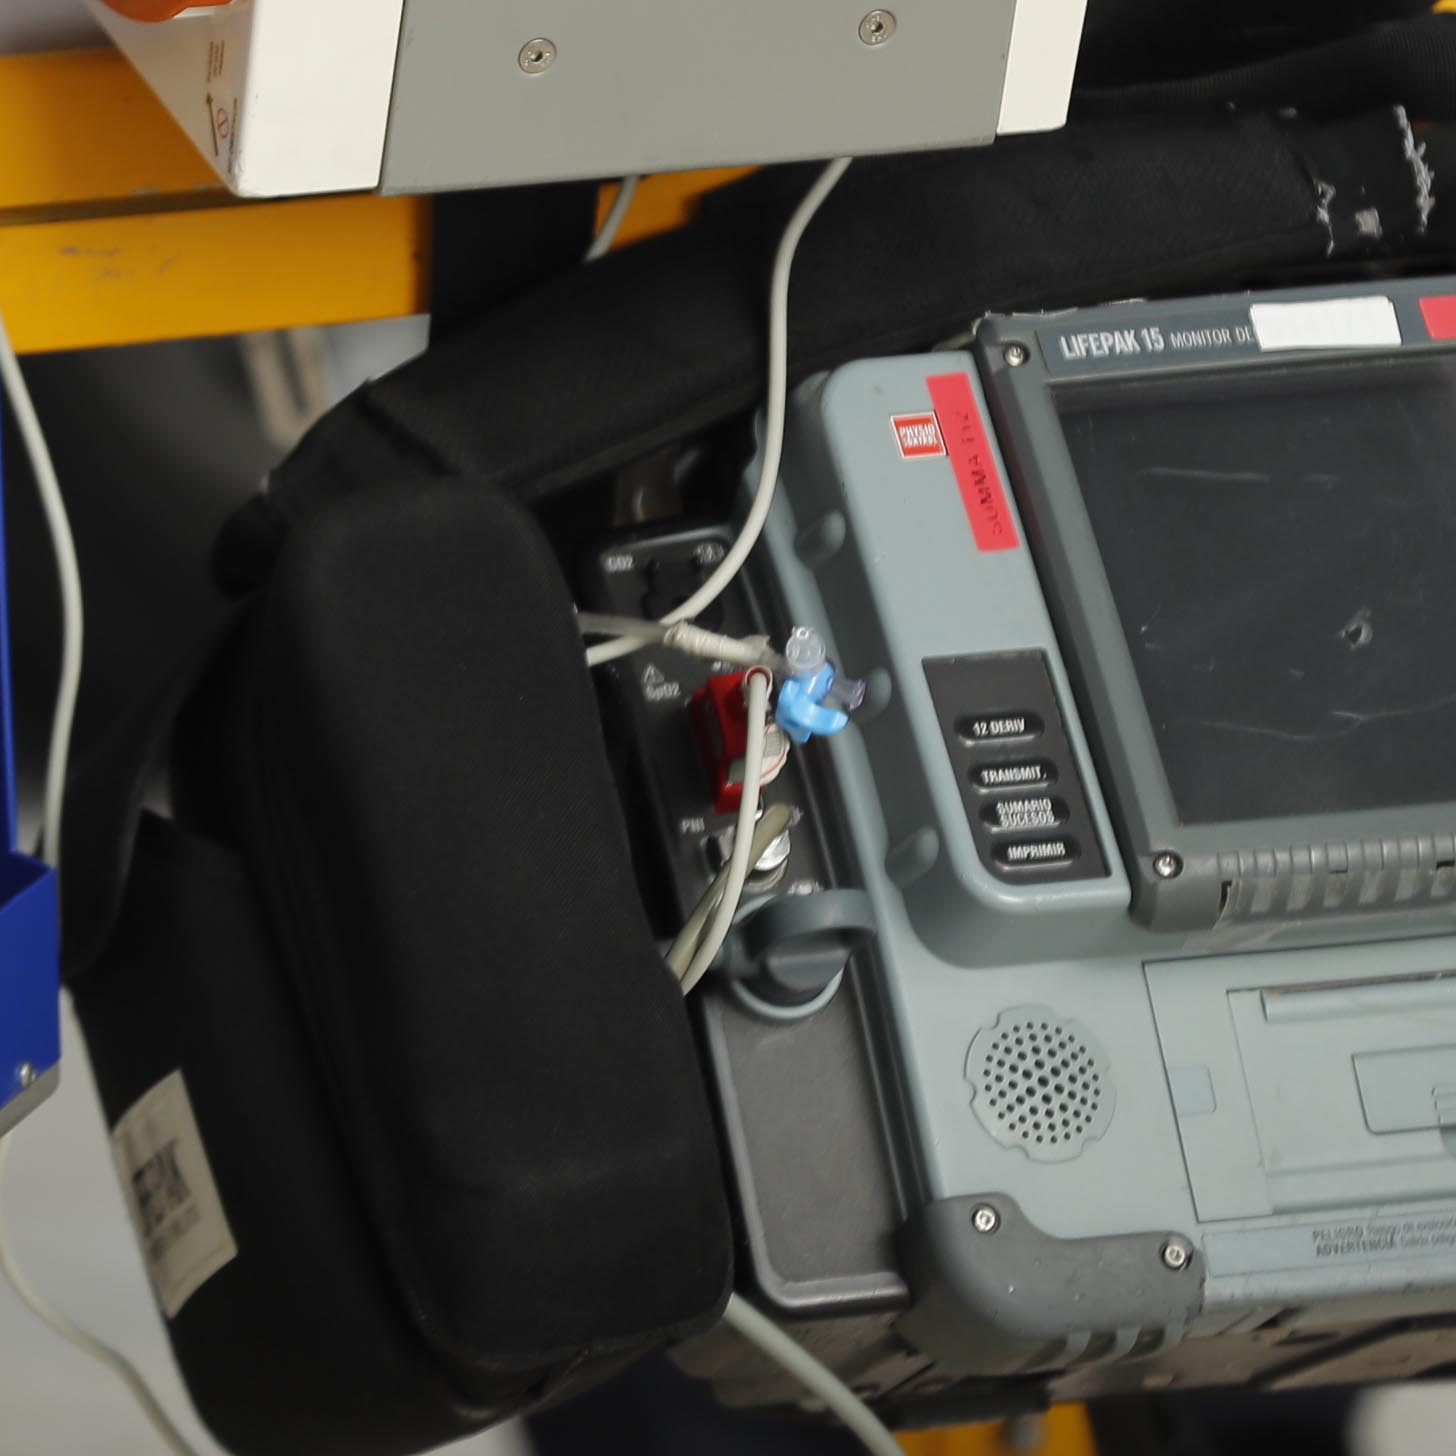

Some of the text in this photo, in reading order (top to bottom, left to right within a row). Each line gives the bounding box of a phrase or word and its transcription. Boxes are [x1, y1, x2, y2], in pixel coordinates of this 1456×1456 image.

[1060, 328, 1141, 360] LIFEPAK
[1141, 327, 1166, 354] 15
[1169, 328, 1232, 350] MONITOR
[972, 717, 1025, 737] 12 DERIV
[995, 797, 1052, 816] SUMARIO
[999, 811, 1056, 828] SUCESOS
[1007, 841, 1066, 862] IMPRIMIR
